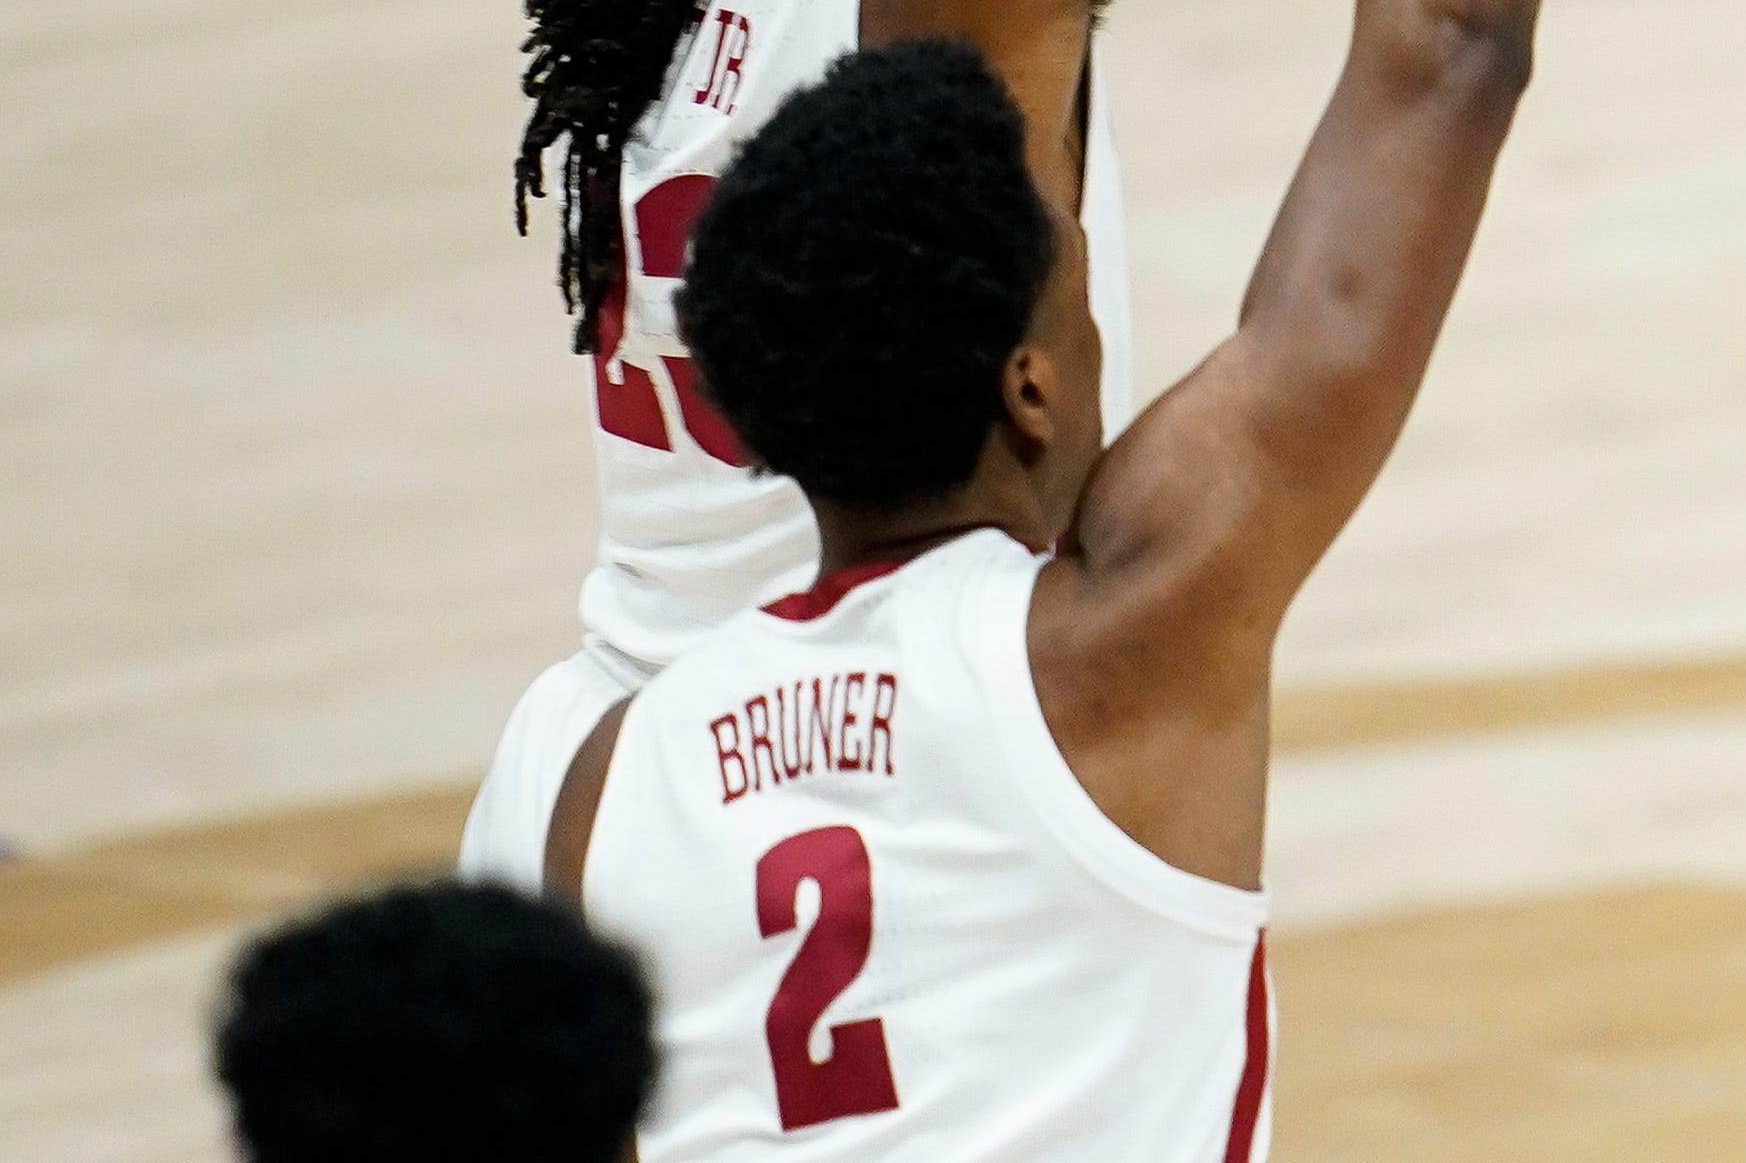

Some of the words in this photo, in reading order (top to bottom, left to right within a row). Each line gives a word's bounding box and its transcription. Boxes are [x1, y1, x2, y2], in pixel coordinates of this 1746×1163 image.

[692, 8, 751, 116] JR
[709, 670, 898, 805] BRUNER
[755, 823, 900, 1133] 2
